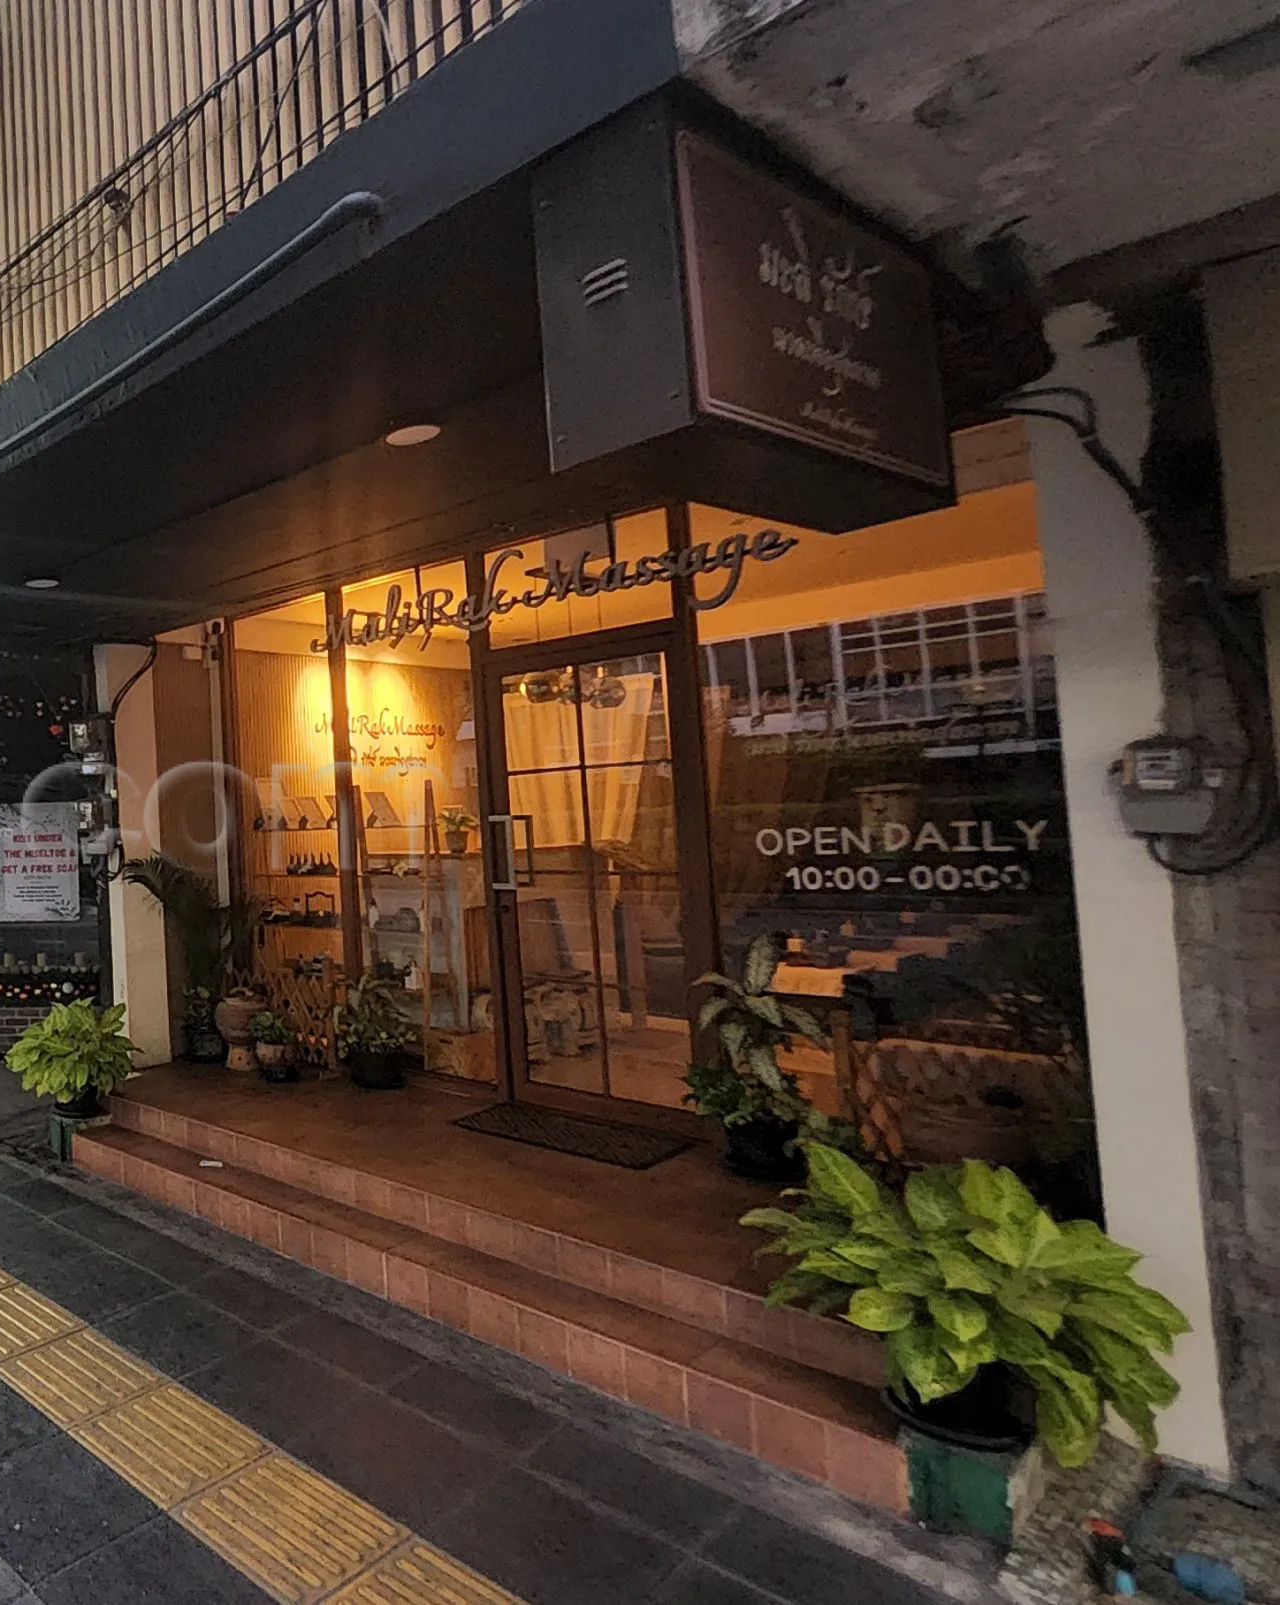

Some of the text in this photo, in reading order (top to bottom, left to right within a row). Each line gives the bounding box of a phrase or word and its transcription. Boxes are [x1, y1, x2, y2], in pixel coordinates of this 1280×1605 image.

[522, 530, 799, 610] Massage
[34, 832, 63, 843] UNDER
[755, 819, 1049, 856] OPEN DAILY
[3, 849, 22, 858] THE
[1, 865, 18, 875] GET
[21, 865, 27, 874] A
[30, 865, 53, 874] FREE
